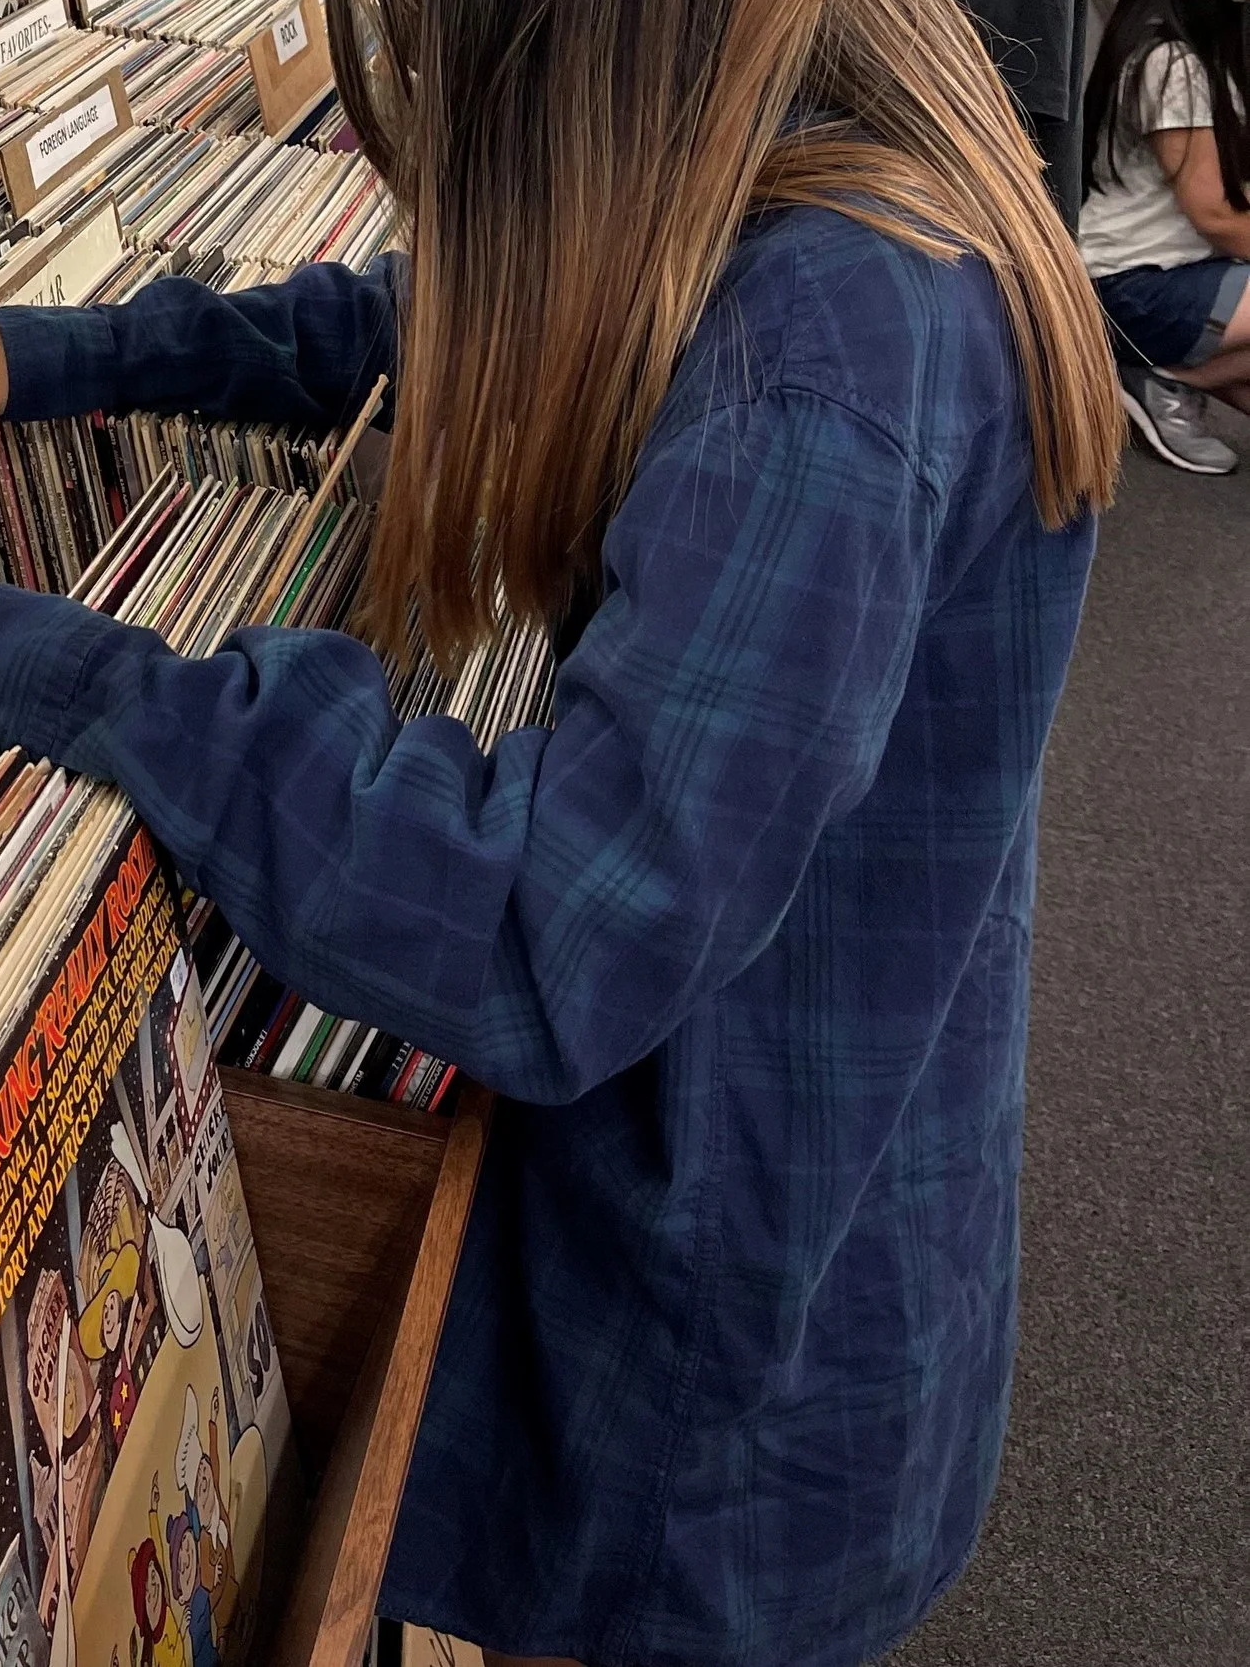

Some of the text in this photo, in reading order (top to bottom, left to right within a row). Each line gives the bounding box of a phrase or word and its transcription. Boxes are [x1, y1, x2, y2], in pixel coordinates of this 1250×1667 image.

[39, 105, 99, 159] FOREIGN LANGUAGE
[280, 21, 297, 47] ROCK
[20, 1142, 49, 1215] AND
[47, 1017, 110, 1153] PERFORMED
[108, 994, 124, 1033] BY
[120, 940, 153, 1006] CAROLE
[152, 890, 176, 946] KING
[26, 1193, 54, 1256] AND
[50, 1119, 92, 1216] LYRICS
[88, 1084, 105, 1122] BY
[102, 994, 148, 1087] MAURICE
[145, 923, 181, 1000] SENDAK
[29, 1097, 49, 1146] TV
[47, 965, 115, 1112] SOUNDTRACK
[111, 871, 166, 987] RECORDINGS
[37, 901, 108, 1068] REALLY
